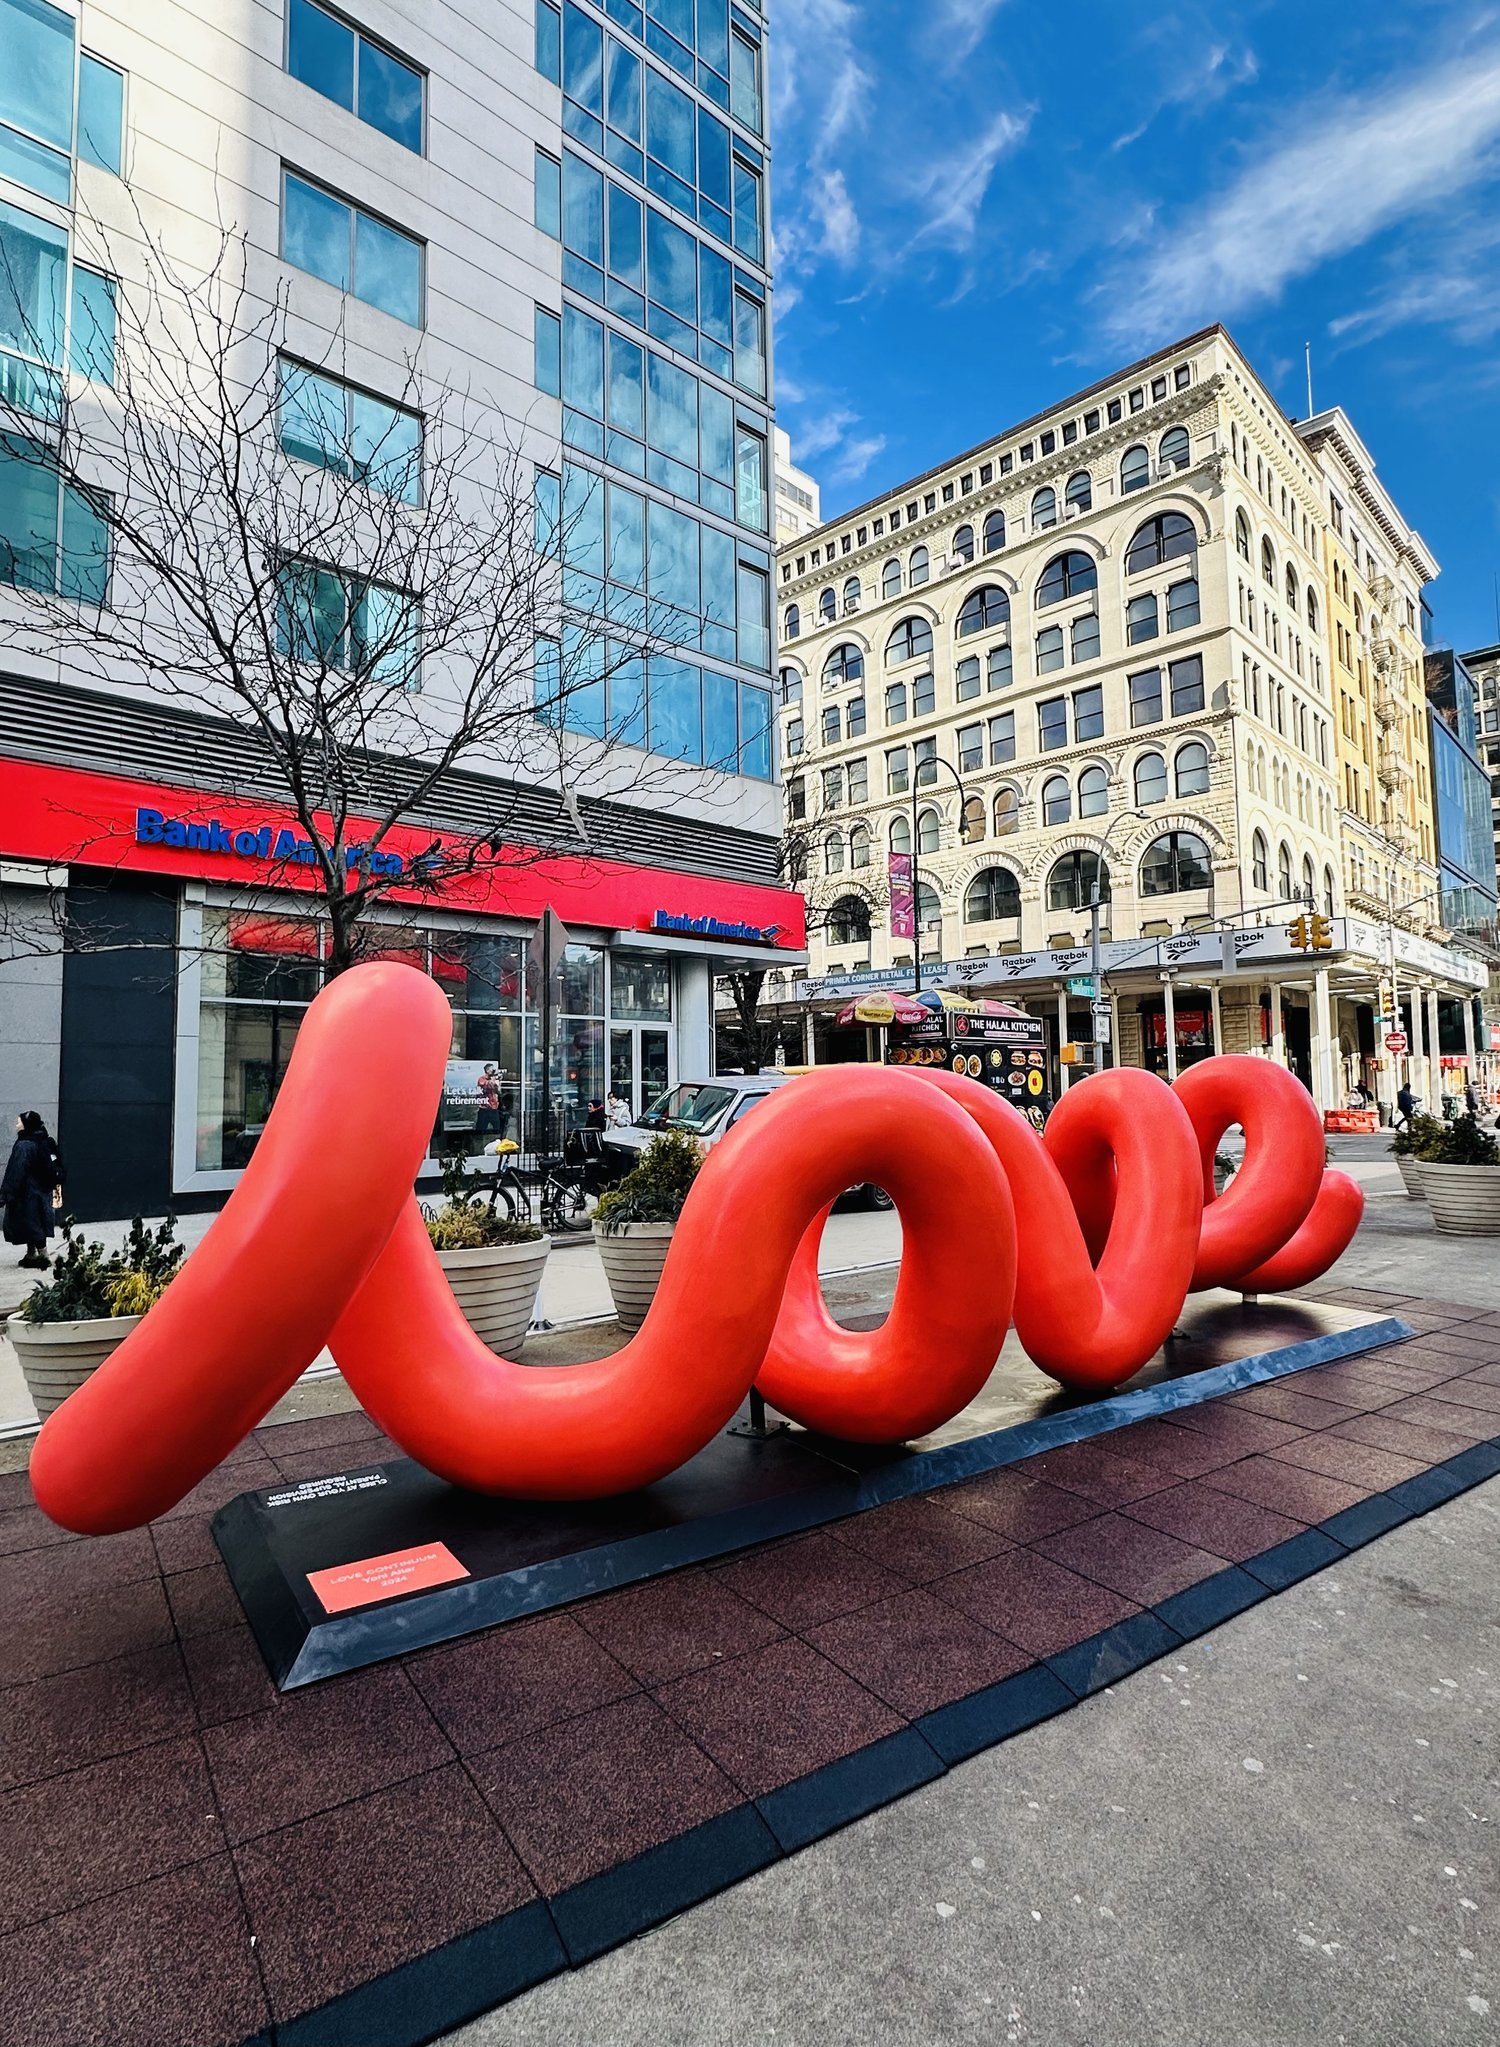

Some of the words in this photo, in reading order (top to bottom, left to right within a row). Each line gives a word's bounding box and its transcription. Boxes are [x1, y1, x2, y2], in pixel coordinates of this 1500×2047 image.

[135, 808, 234, 851] Bank
[234, 827, 272, 858] of
[272, 829, 403, 876] Amrca
[654, 910, 693, 931] Bank
[692, 916, 708, 932] of
[707, 917, 760, 939] America
[1164, 939, 1200, 949] eebok
[1002, 956, 1036, 967] Reebok
[1051, 951, 1088, 963] Reebok
[851, 972, 879, 982] CORNER
[880, 969, 905, 979] RETAIL
[906, 968, 921, 977] FO
[923, 964, 947, 975] LEASE
[956, 962, 989, 972] Reebok
[970, 1019, 985, 1030] THE
[985, 1020, 1010, 1031] HALAL
[1011, 1022, 1041, 1033] KITCHEN
[446, 1086, 466, 1096] Let's
[468, 1086, 484, 1095] talk
[446, 1096, 490, 1105] retirement
[298, 1475, 347, 1490] REQUIRED
[333, 1474, 381, 1488] PARENTAL
[359, 1478, 388, 1489] CLIMB
[268, 1484, 333, 1501] SUPERVISION
[292, 1493, 317, 1503] OWN
[318, 1487, 346, 1498] YOUR
[266, 1498, 291, 1508] RISK
[330, 1572, 363, 1585] LOVE
[366, 1554, 437, 1575] CONTINUUM
[361, 1573, 388, 1584] Yoni
[390, 1566, 416, 1577] Alter
[380, 1575, 408, 1587] 2024
